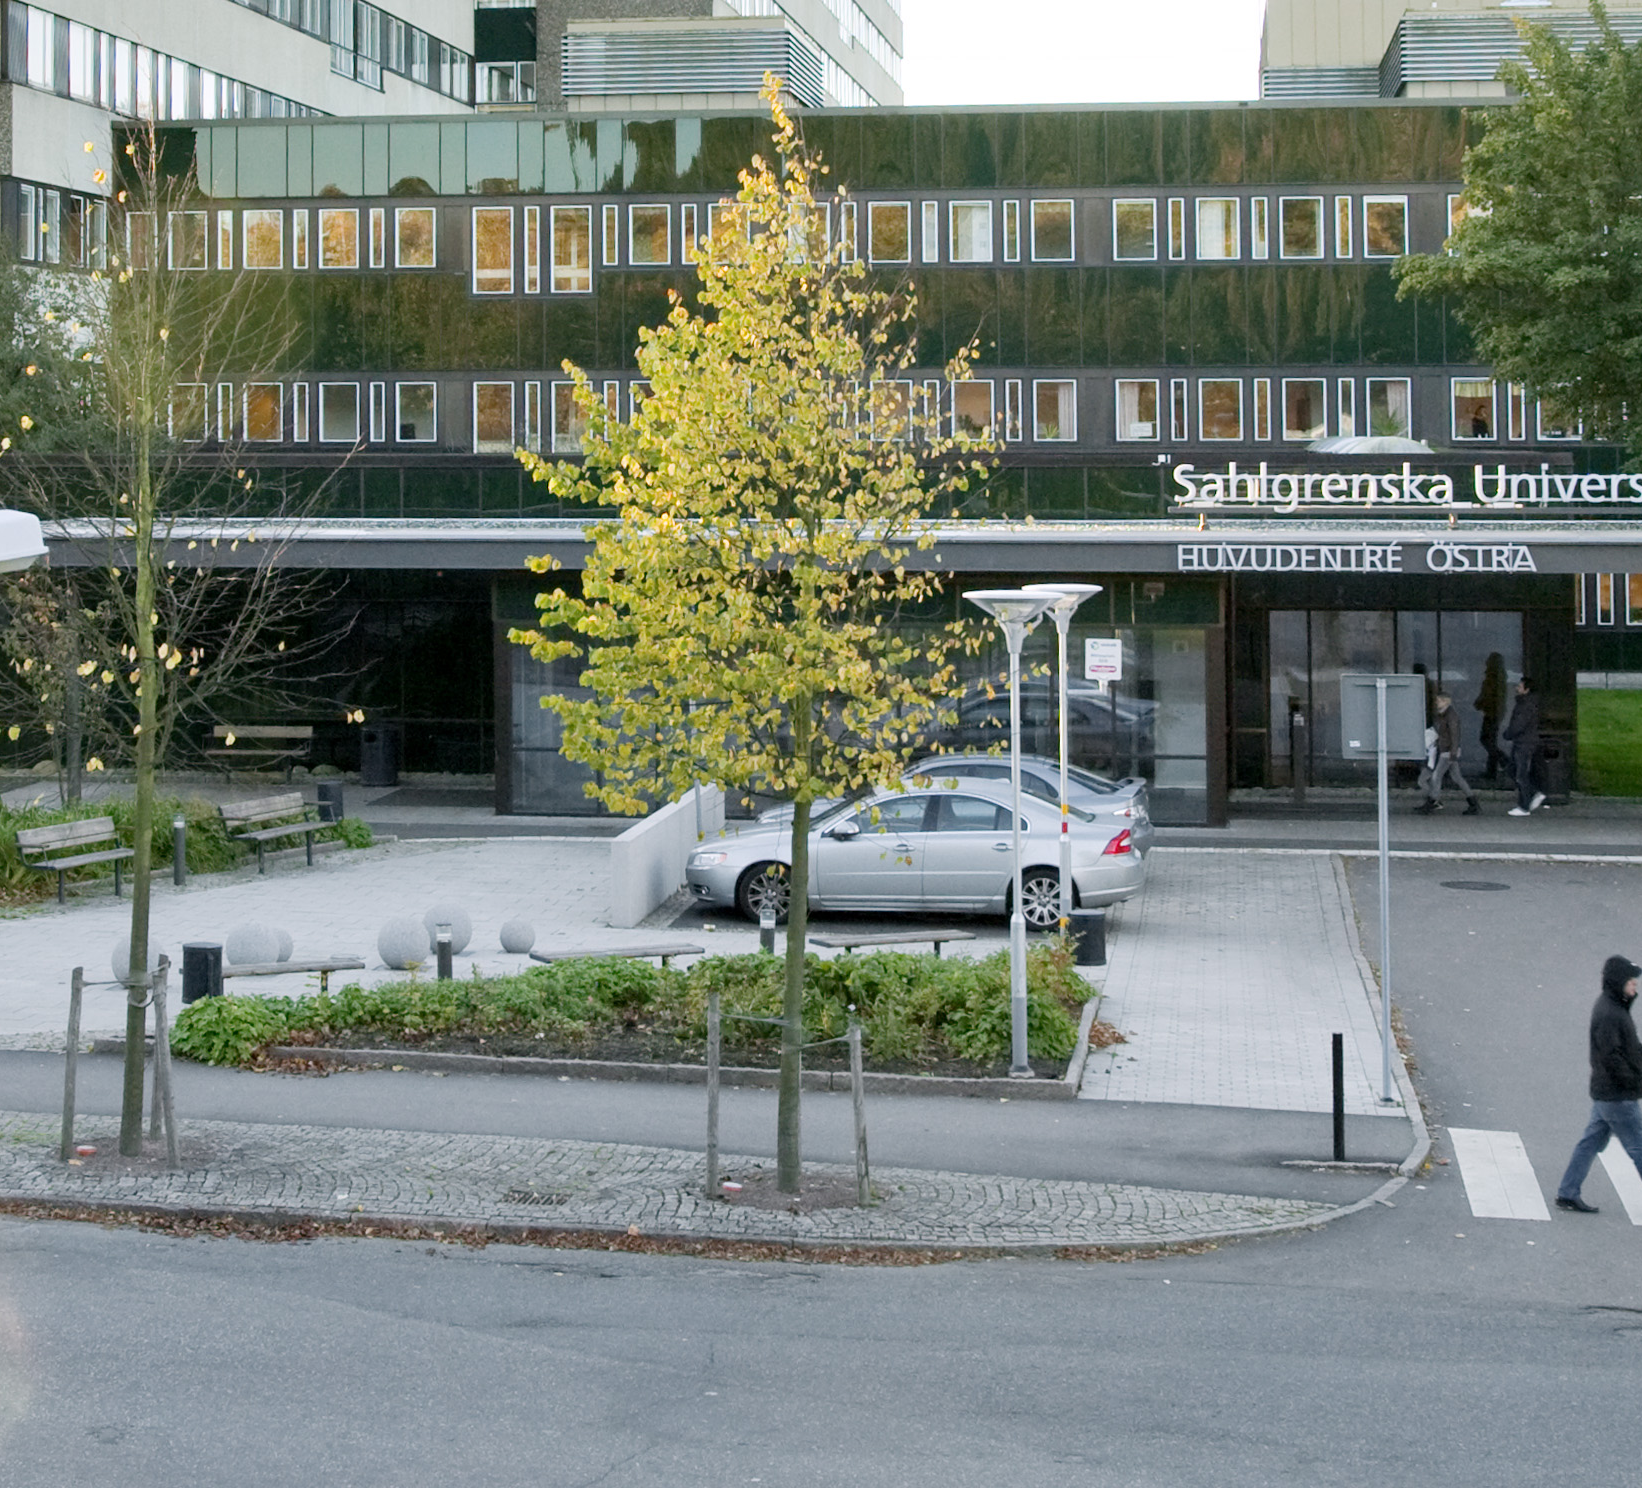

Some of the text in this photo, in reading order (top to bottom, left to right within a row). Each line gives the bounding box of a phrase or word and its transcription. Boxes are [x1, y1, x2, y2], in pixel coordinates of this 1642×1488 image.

[1173, 462, 1453, 512] Sahlgrenska
[1177, 541, 1537, 572] HUVUDENTRÉ ÖSTRA
